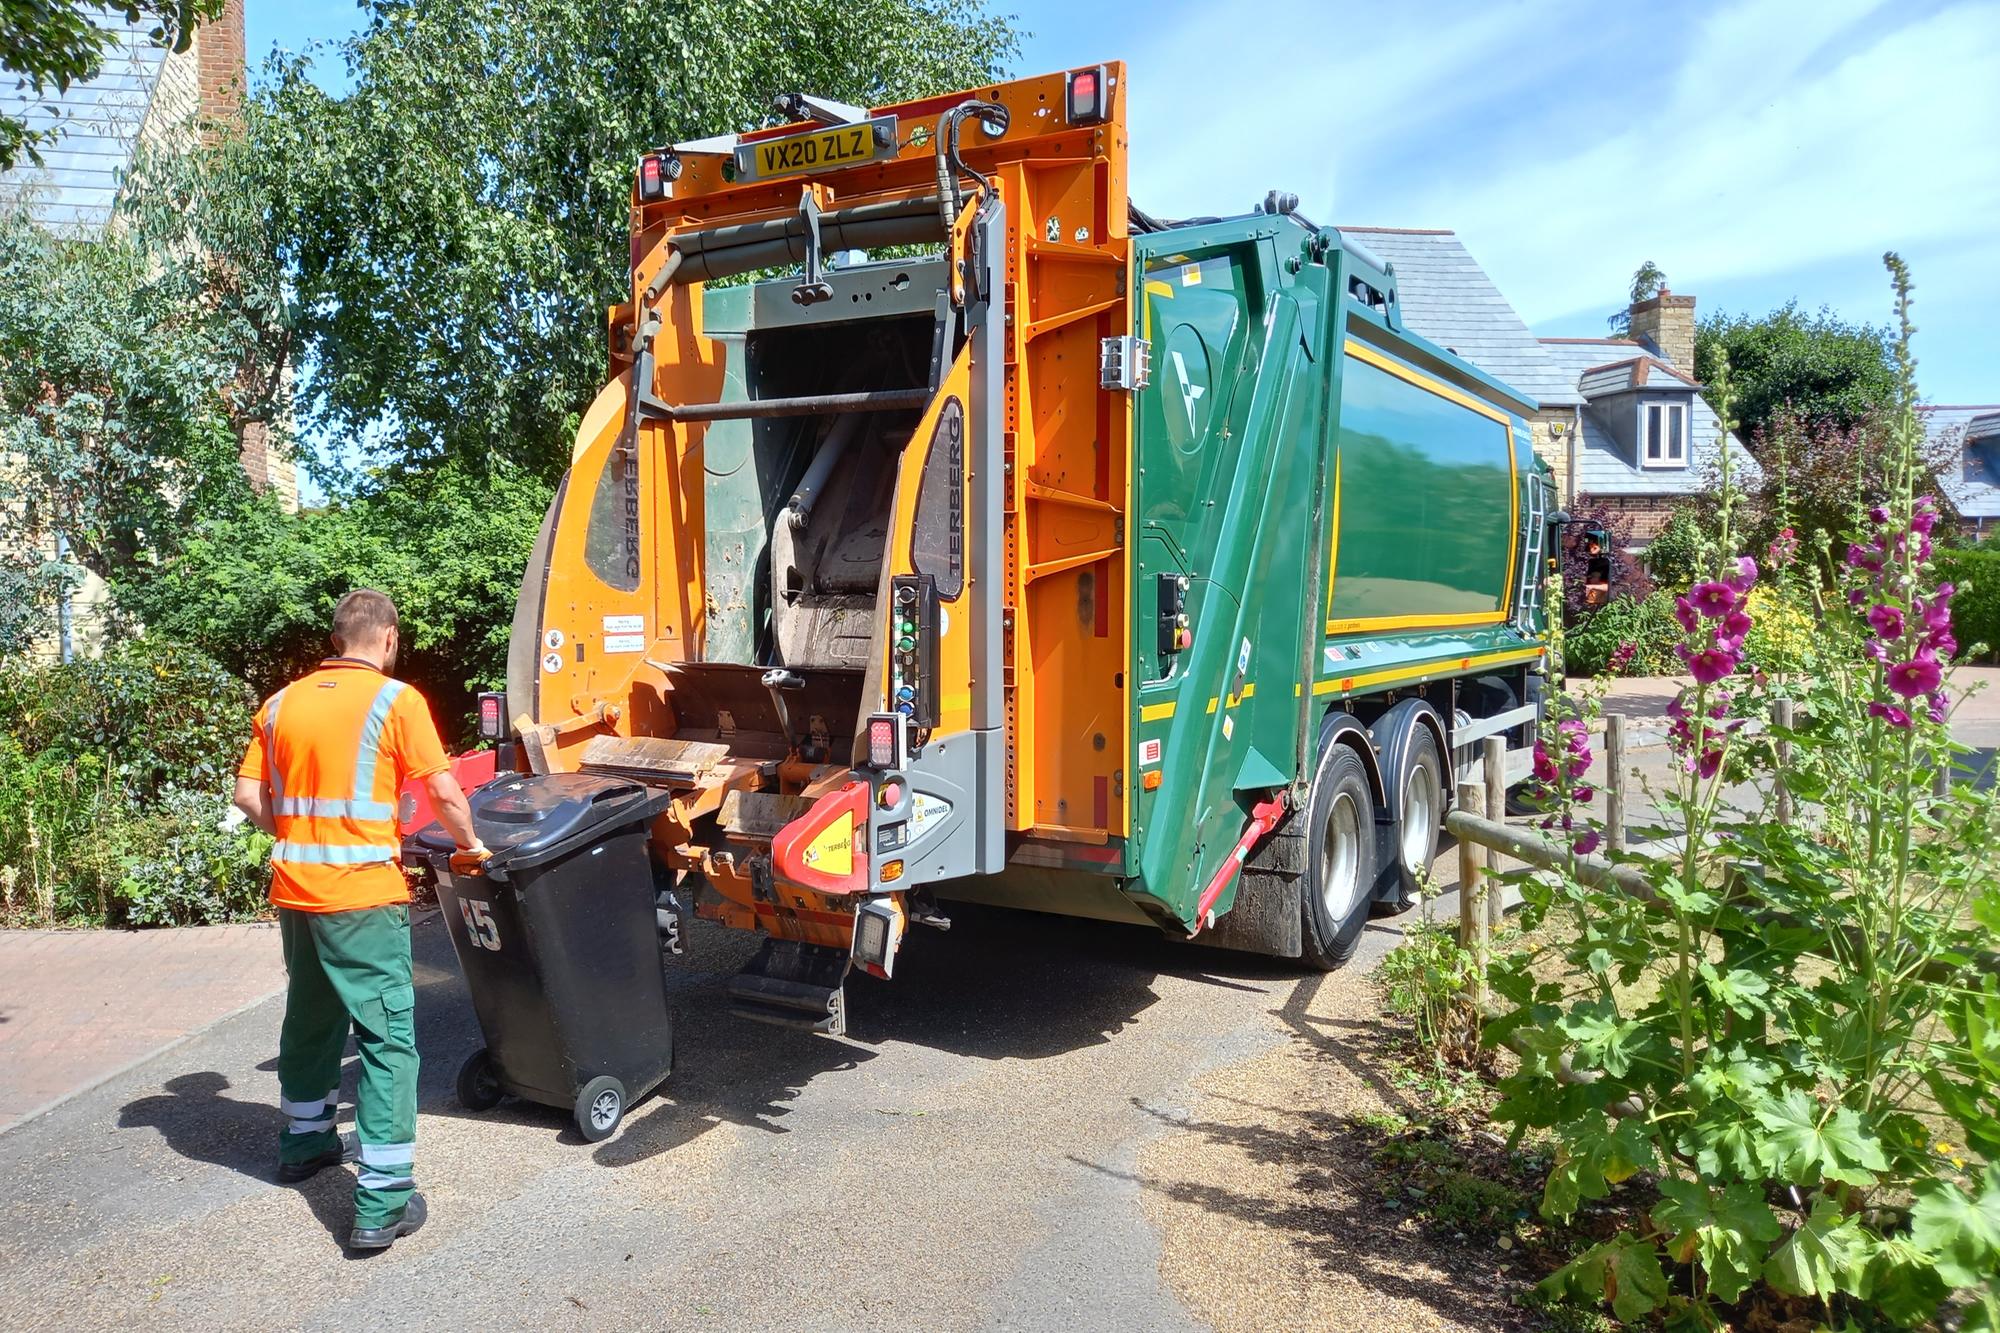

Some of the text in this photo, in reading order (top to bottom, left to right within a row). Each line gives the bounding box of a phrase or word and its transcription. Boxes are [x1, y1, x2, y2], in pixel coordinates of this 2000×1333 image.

[764, 131, 864, 170] VX20 ZLZ
[625, 450, 640, 578] ERBERG
[949, 416, 961, 577] TERBERG
[924, 805, 948, 817] OMNIDEL
[457, 896, 502, 951] 15
